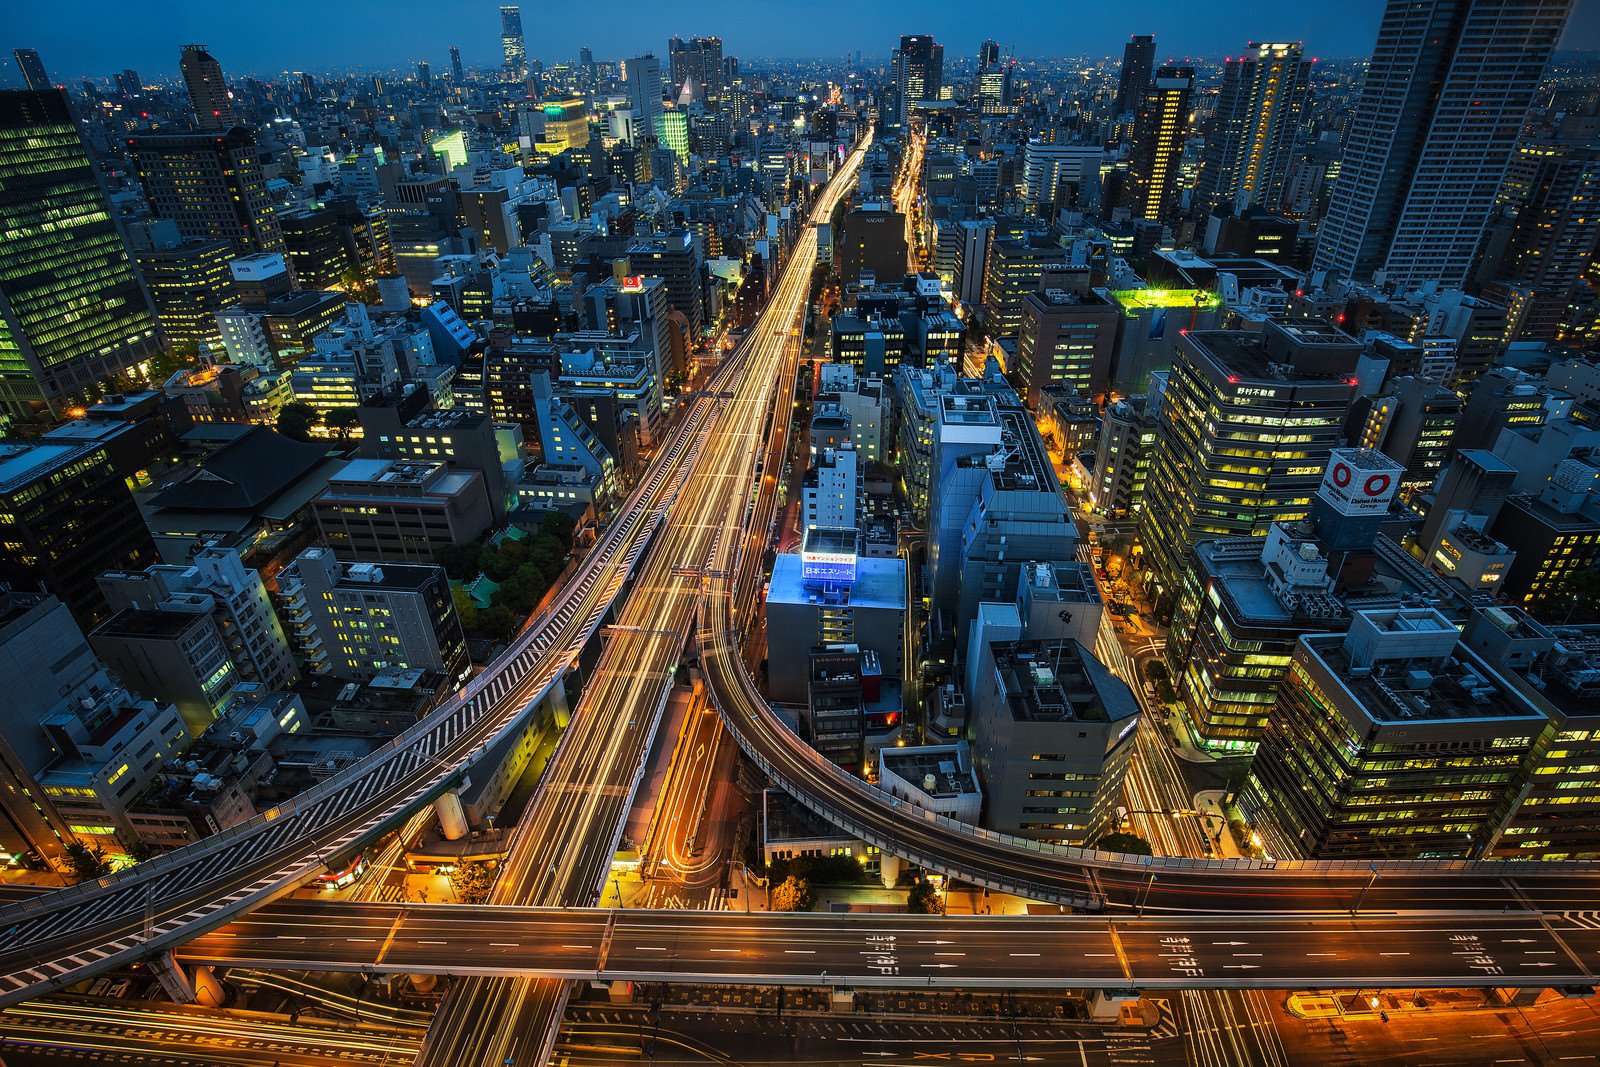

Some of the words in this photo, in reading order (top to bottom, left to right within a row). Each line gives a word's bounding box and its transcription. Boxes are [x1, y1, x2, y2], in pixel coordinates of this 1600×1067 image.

[1237, 387, 1276, 397] 野村不動産
[1328, 489, 1341, 502] Group
[805, 567, 853, 575] 日本エスリード
[866, 955, 899, 975] 神戸
[1167, 958, 1204, 976] 神戸
[1462, 955, 1504, 974] 神戸
